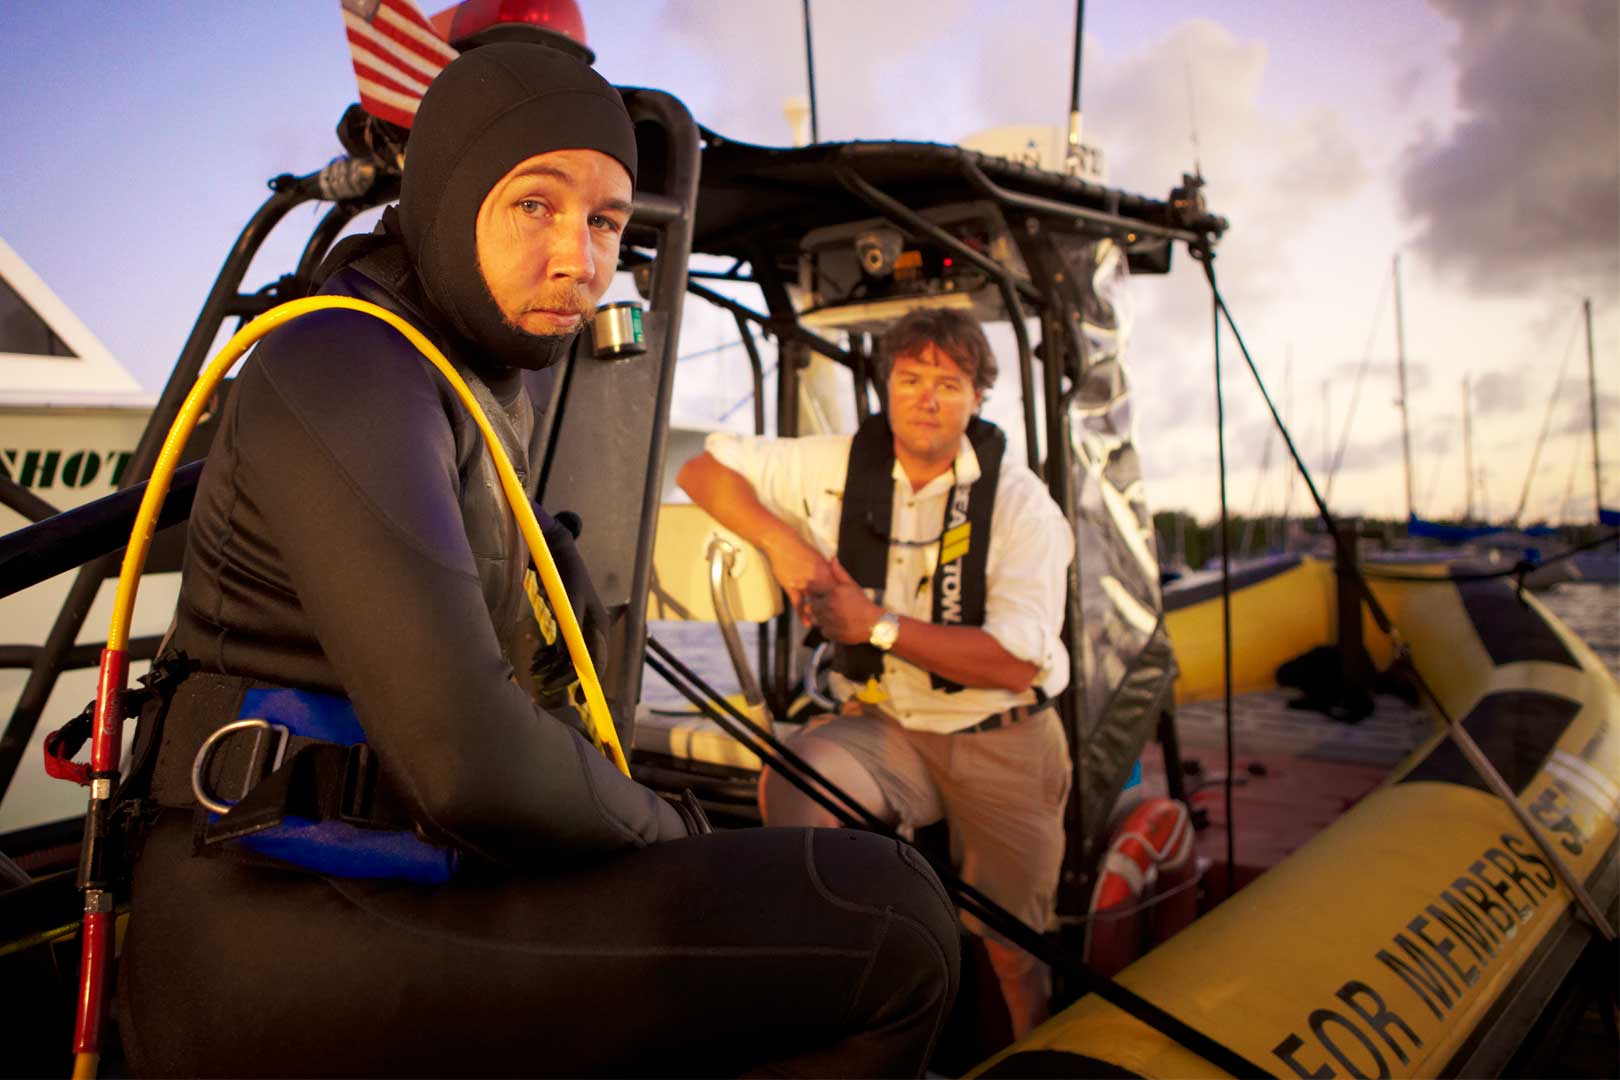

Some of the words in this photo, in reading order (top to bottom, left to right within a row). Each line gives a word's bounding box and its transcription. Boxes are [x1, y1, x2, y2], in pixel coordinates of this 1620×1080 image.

[942, 557, 962, 623] TOW
[1271, 980, 1424, 1080] FOR
[1375, 833, 1558, 1023] MEMBERS
